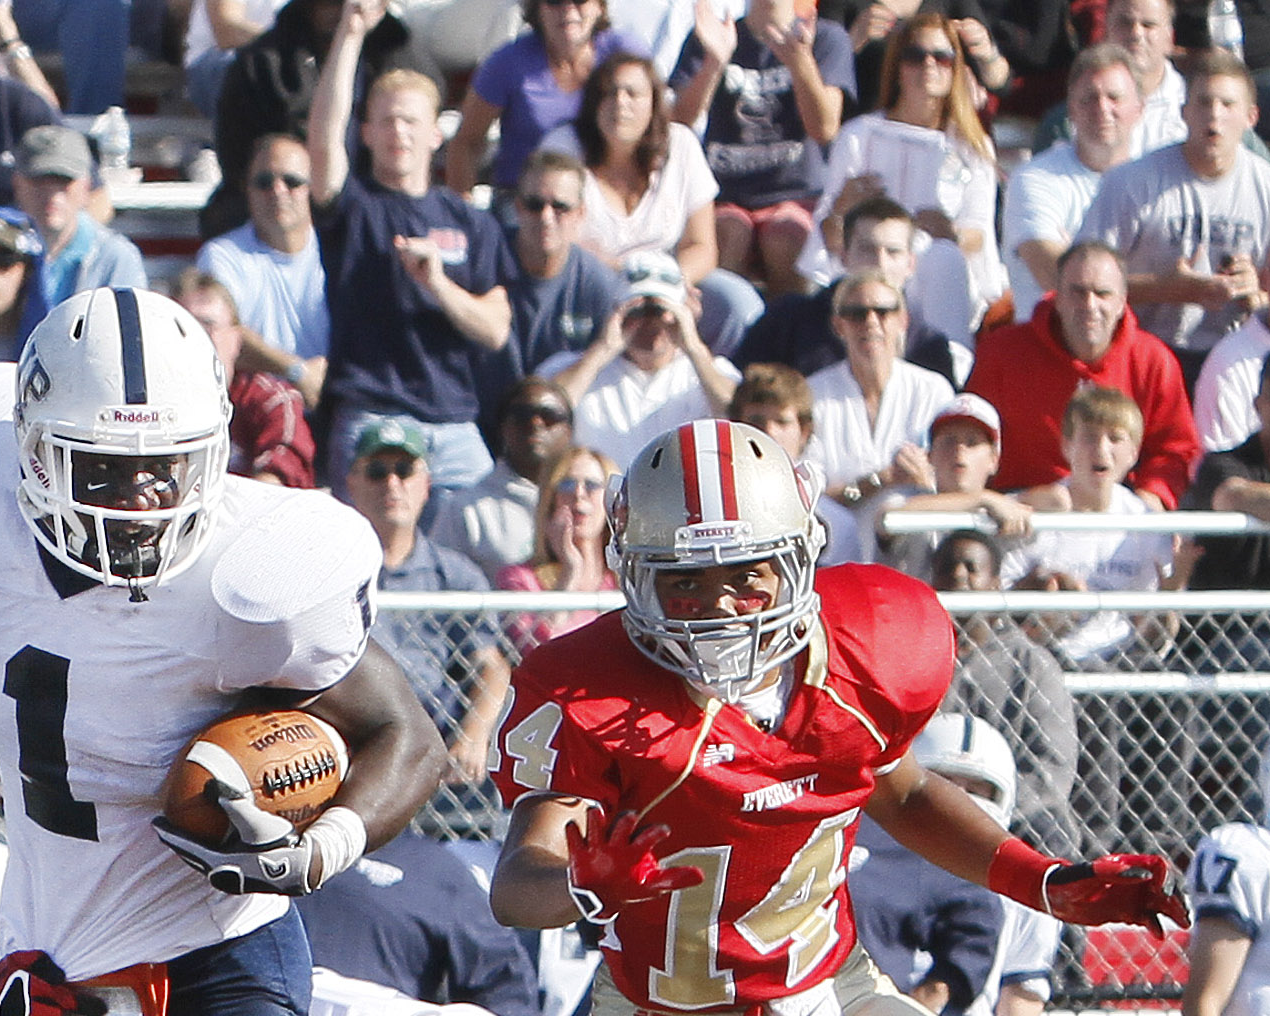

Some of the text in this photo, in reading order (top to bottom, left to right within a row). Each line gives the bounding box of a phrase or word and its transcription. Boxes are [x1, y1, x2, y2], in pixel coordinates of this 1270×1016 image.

[113, 410, 160, 423] Riddell
[2, 643, 100, 843] 1
[249, 723, 318, 752] Wilson
[740, 773, 819, 813] EVERETT
[1194, 850, 1238, 895] 17
[648, 806, 861, 1011] 14
